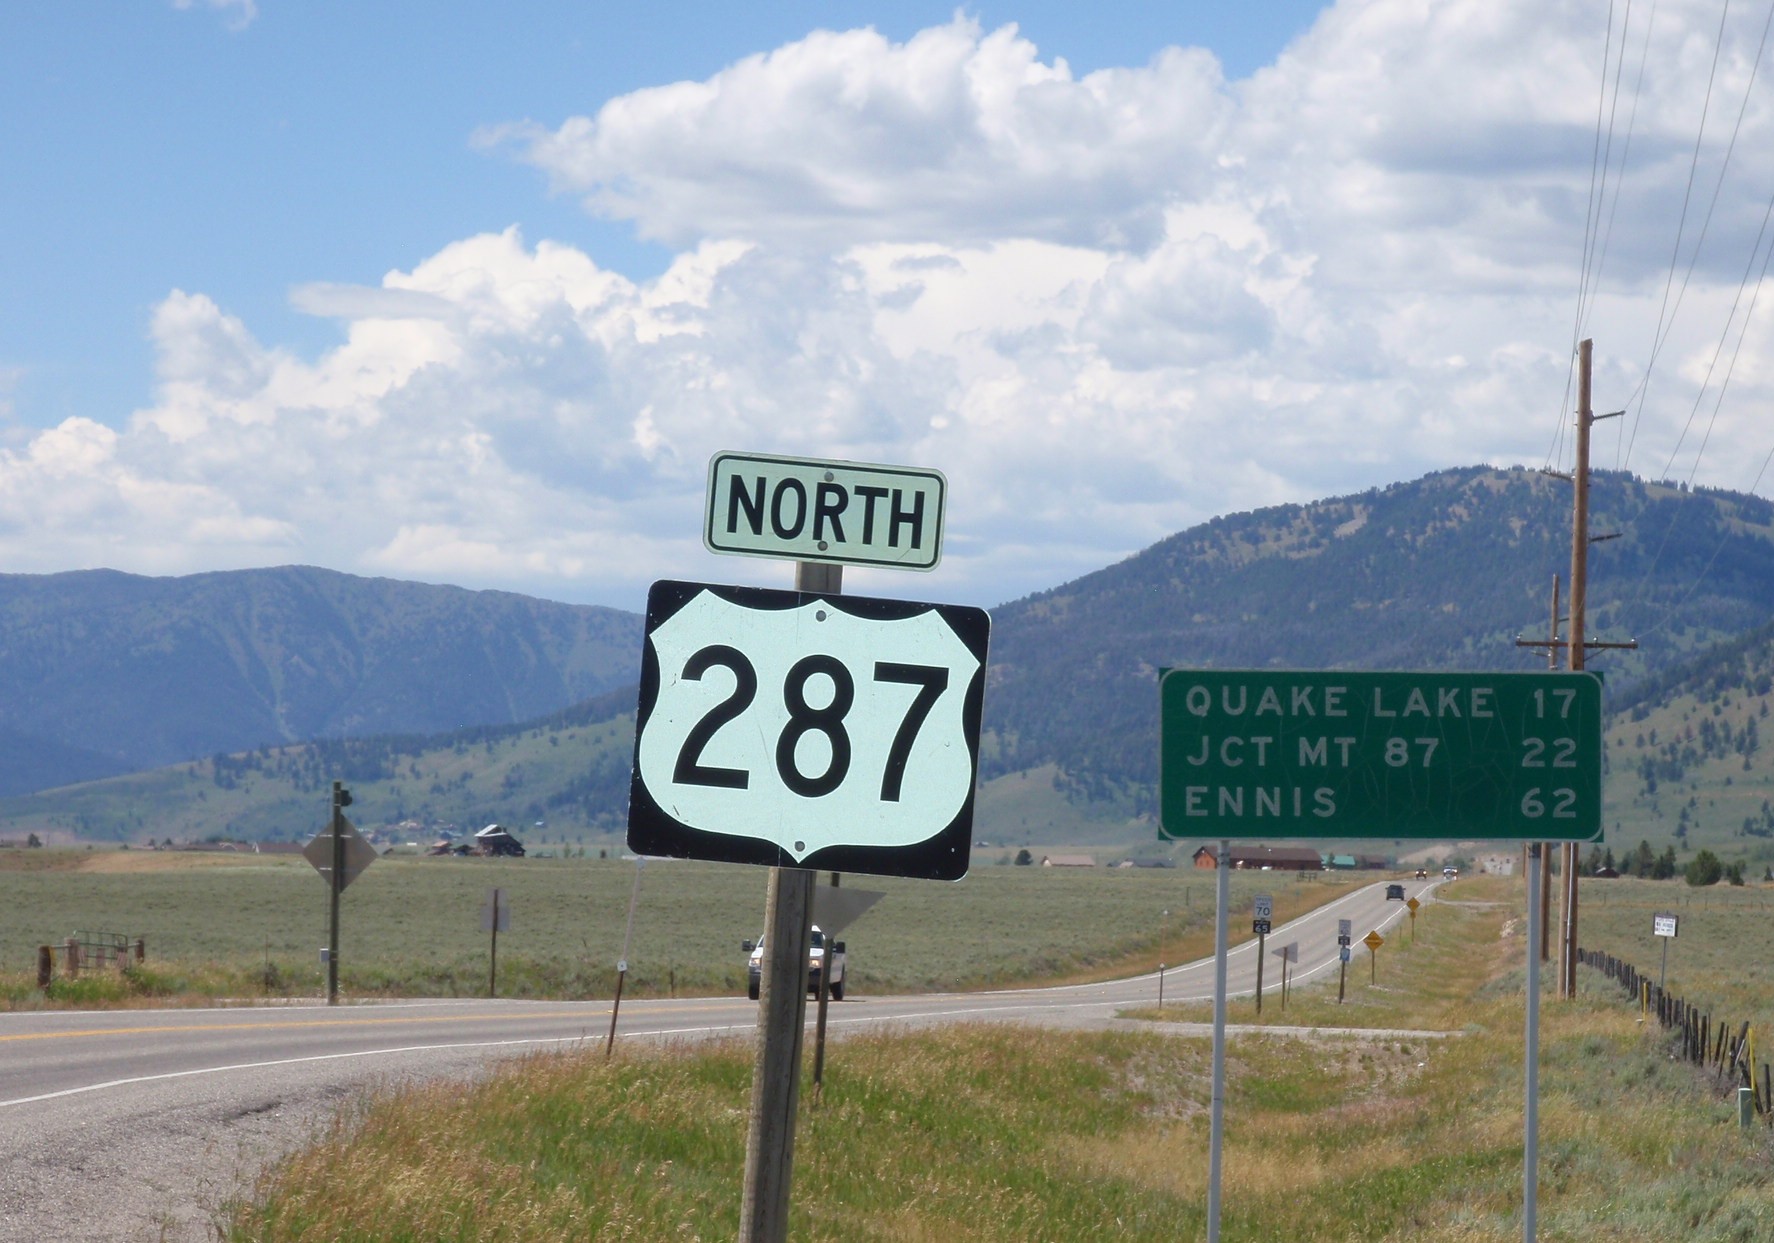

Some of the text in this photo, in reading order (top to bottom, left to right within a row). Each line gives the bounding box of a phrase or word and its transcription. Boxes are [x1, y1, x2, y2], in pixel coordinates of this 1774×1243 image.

[727, 474, 925, 550] NORTH
[1186, 685, 1577, 718] QUAKE LAKE 17
[672, 644, 950, 802] 287
[1187, 735, 1577, 768] JCT MT 87 22
[1185, 785, 1577, 818] ENNIS 62
[1256, 906, 1270, 916] 70
[1255, 924, 1268, 932] 65
